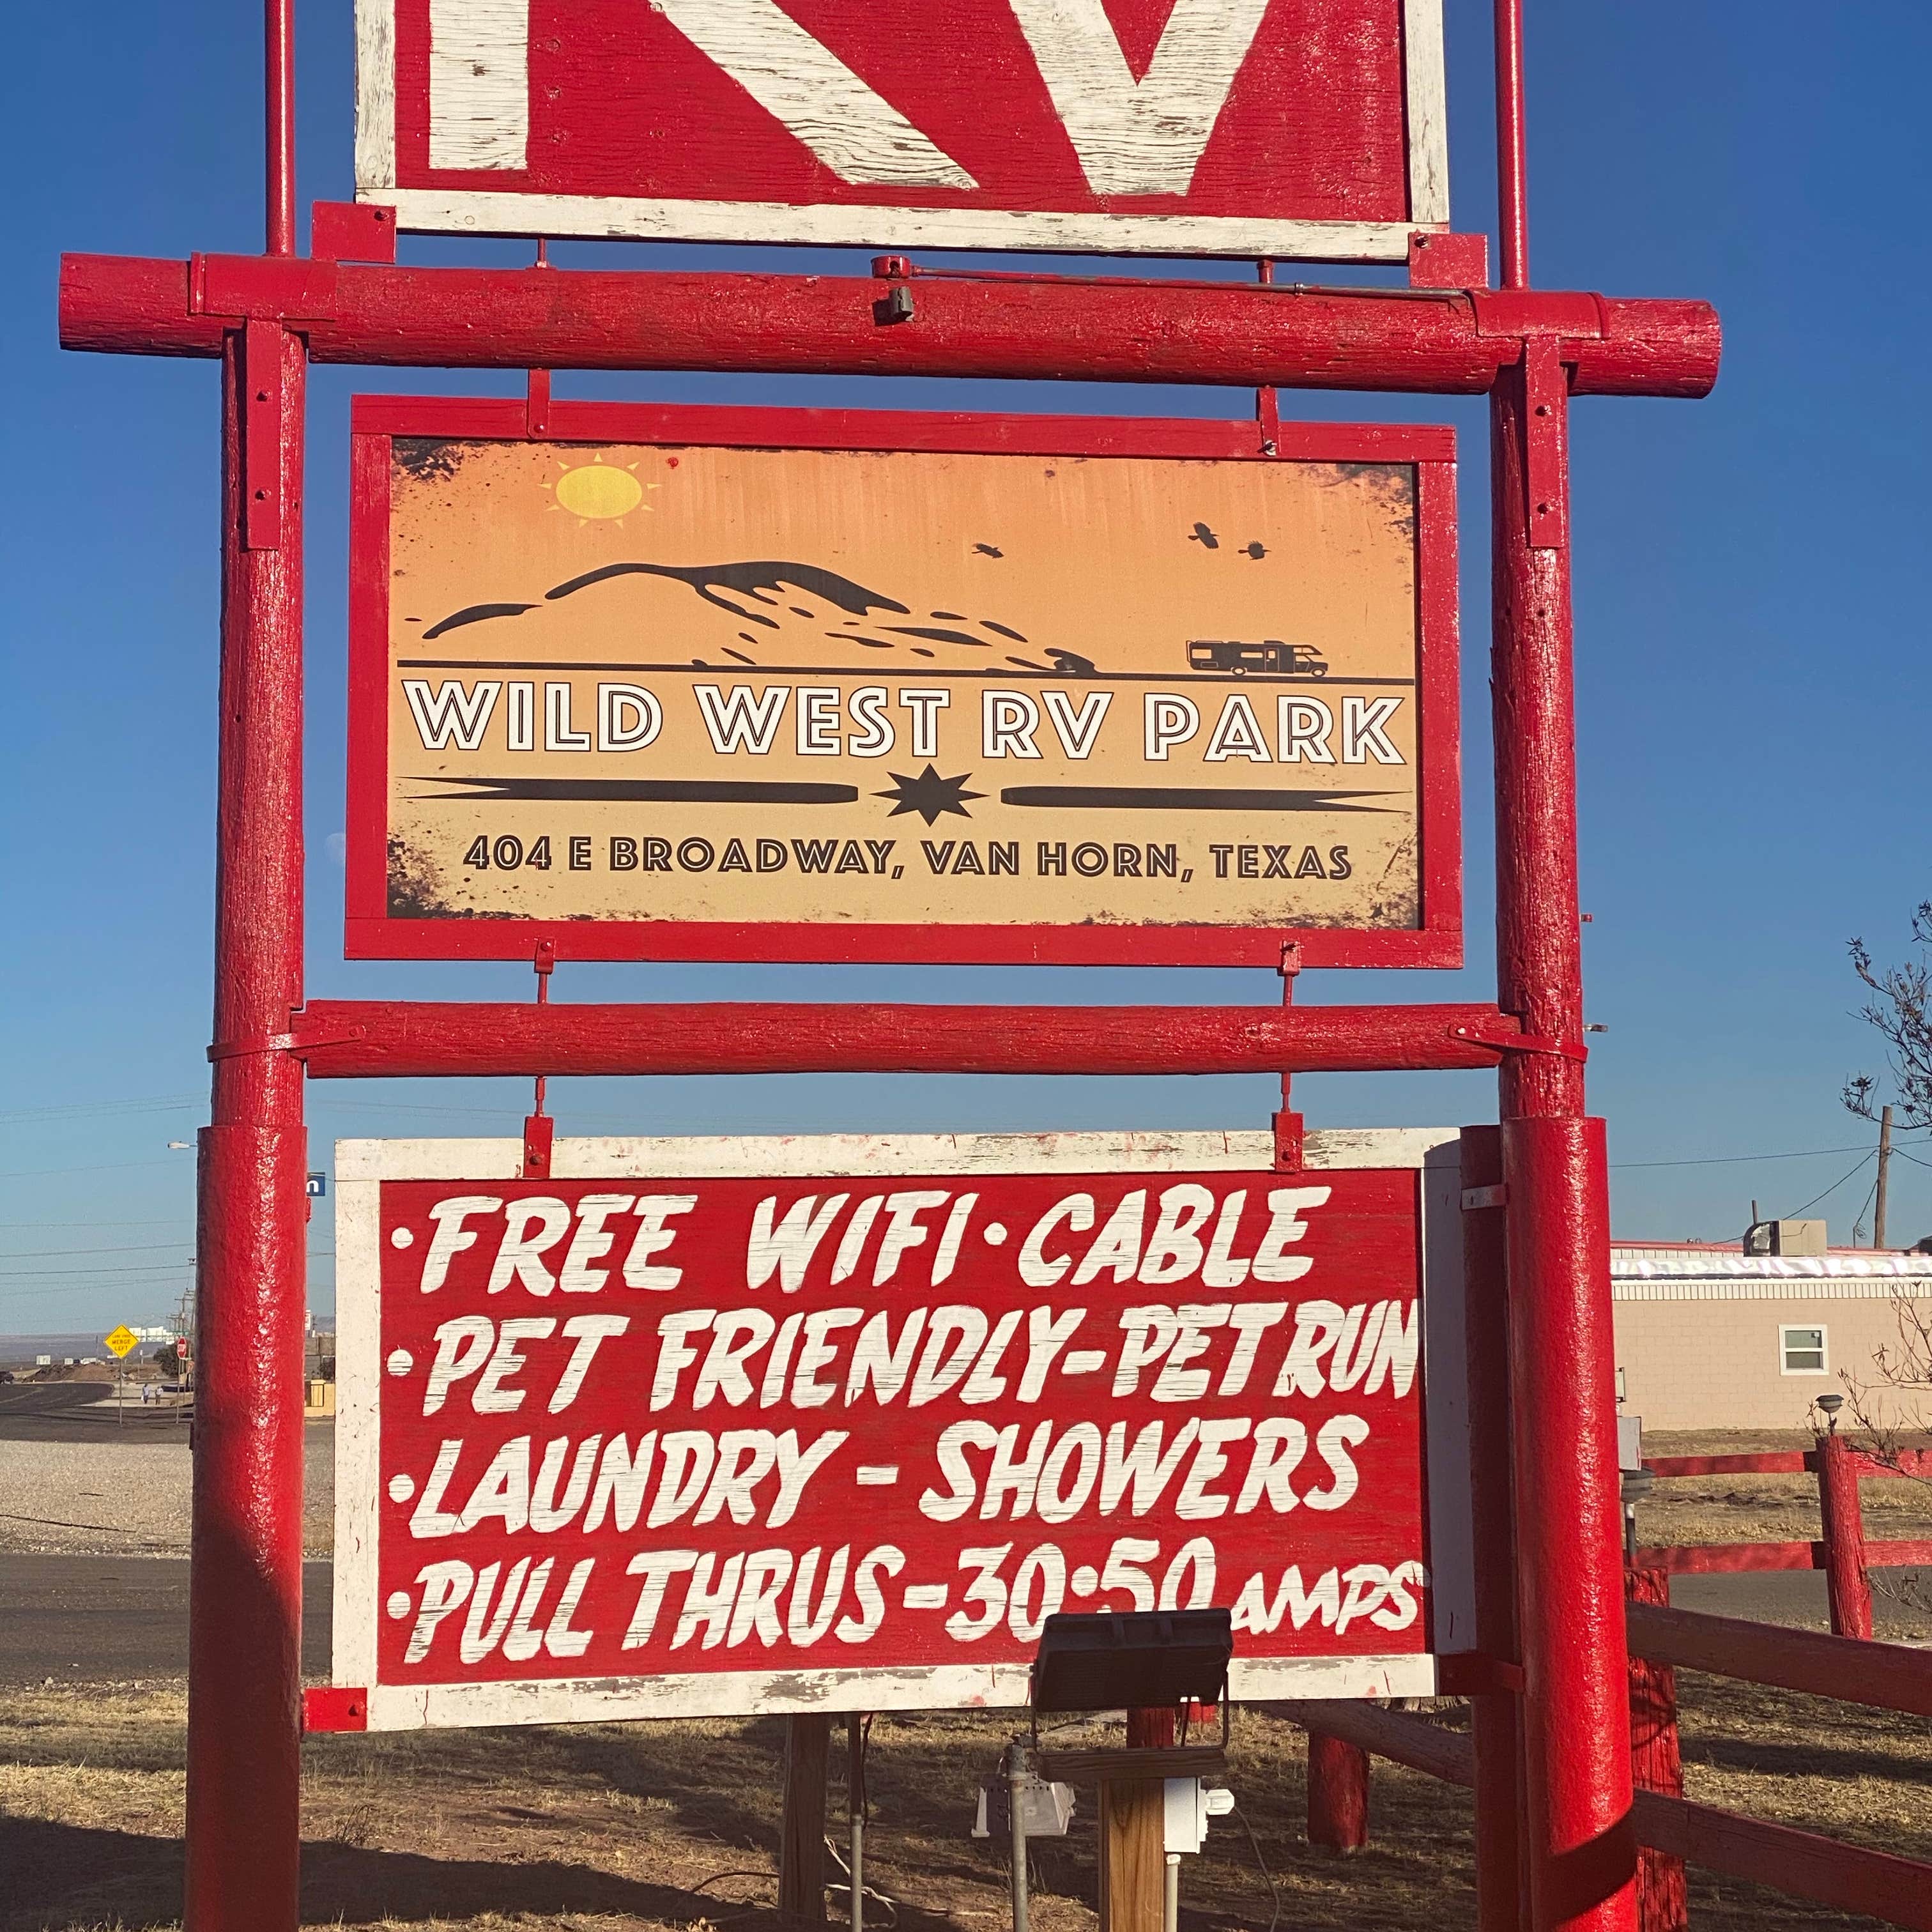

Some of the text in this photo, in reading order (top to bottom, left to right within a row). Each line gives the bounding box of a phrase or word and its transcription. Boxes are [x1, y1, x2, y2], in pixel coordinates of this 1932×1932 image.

[401, 680, 1407, 765] WILD WEST RV PARK
[463, 835, 1351, 882] 404 E BROADWAY, VAN HORN, TEXAS
[420, 1194, 698, 1296] FREE
[423, 1315, 630, 1416] PET
[1271, 1299, 1418, 1399] RUN
[409, 1429, 850, 1538] LAUNDRY
[919, 1414, 1369, 1523] SHOWERS
[404, 1557, 595, 1664] PULL
